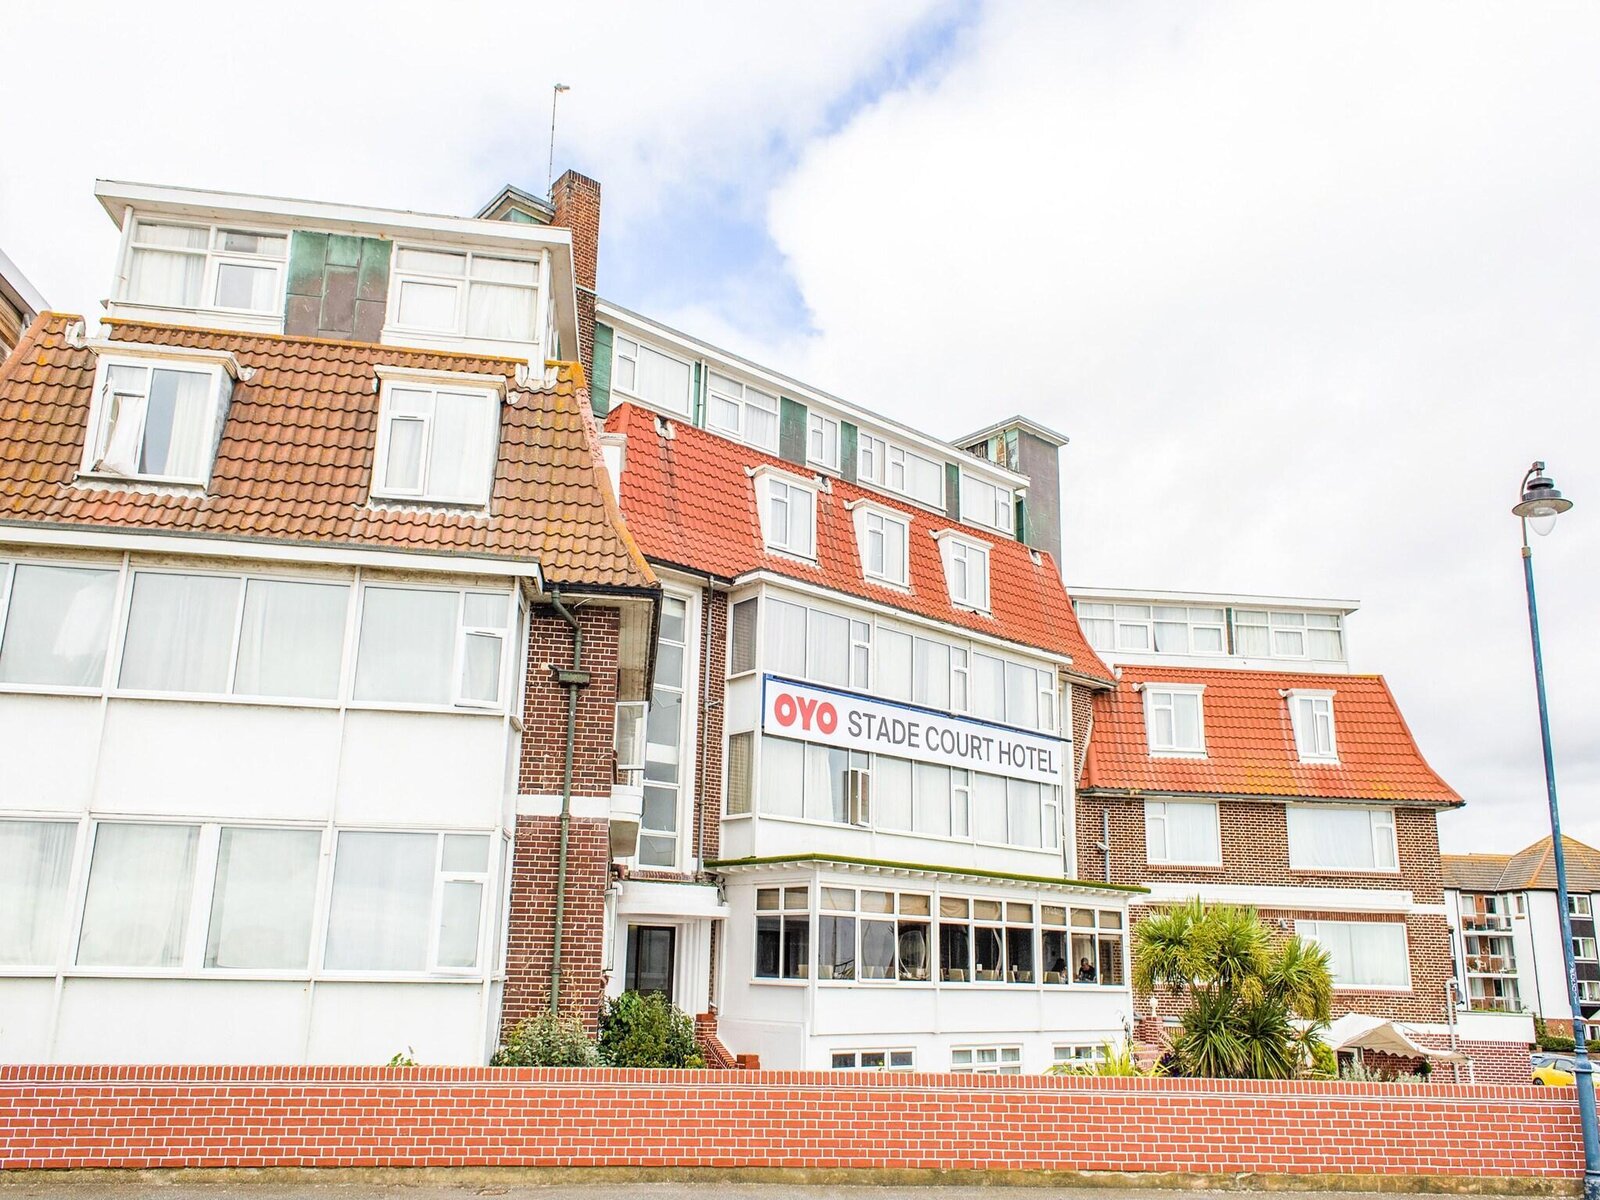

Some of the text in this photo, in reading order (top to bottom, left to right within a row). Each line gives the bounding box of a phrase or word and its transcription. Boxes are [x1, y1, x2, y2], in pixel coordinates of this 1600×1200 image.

[774, 693, 1058, 774] OYO STADE COURT HOTEL
